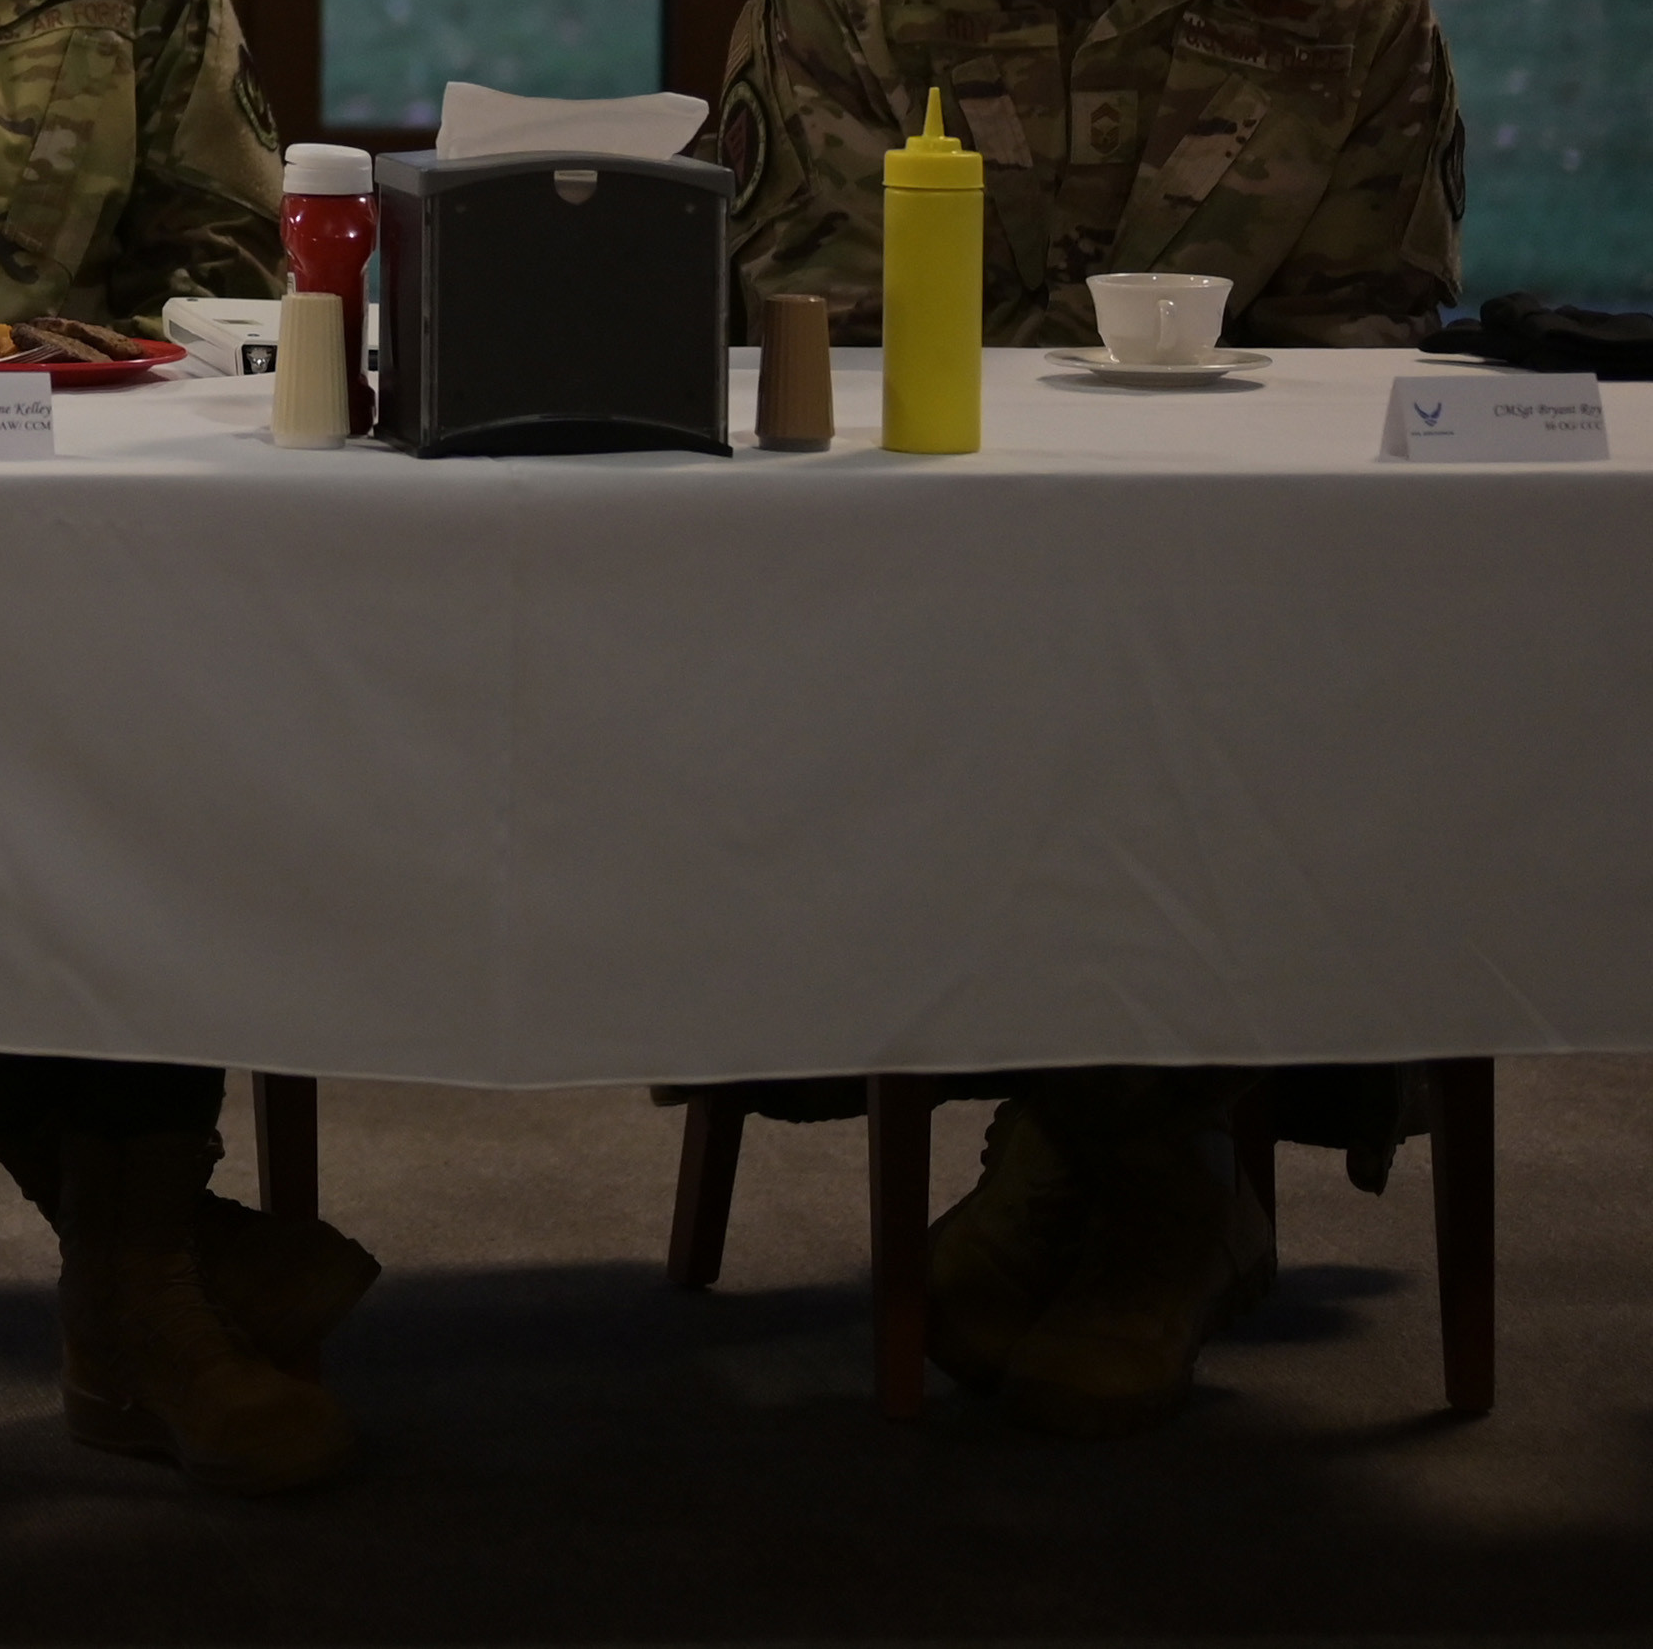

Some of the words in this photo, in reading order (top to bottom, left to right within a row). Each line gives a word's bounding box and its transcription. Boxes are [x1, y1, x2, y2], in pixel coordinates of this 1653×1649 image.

[31, 8, 63, 35] AIR
[14, 401, 52, 418] Kelley
[24, 421, 51, 431] CCM
